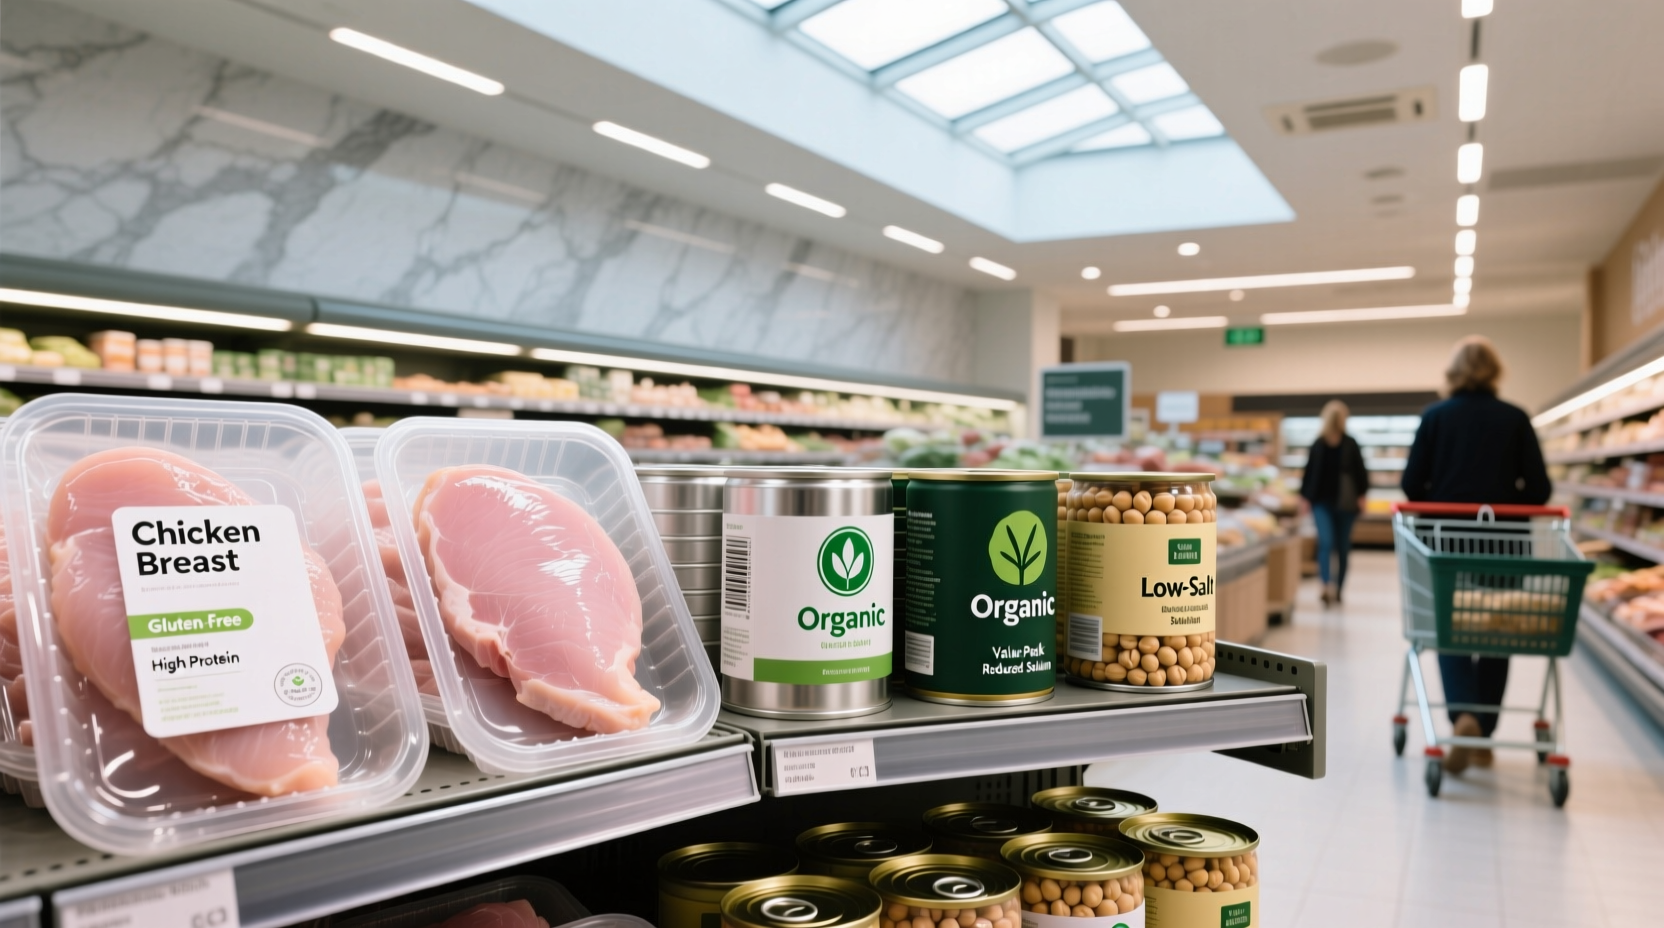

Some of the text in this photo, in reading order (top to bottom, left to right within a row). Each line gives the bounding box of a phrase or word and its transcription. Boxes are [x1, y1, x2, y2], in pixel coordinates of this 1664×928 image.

[131, 518, 261, 546] Chicken
[136, 549, 240, 576] Breast
[797, 602, 886, 638] Organic
[970, 591, 1056, 626] Organic
[148, 613, 242, 633] Gluten-Free
[152, 651, 240, 674] High Protein
